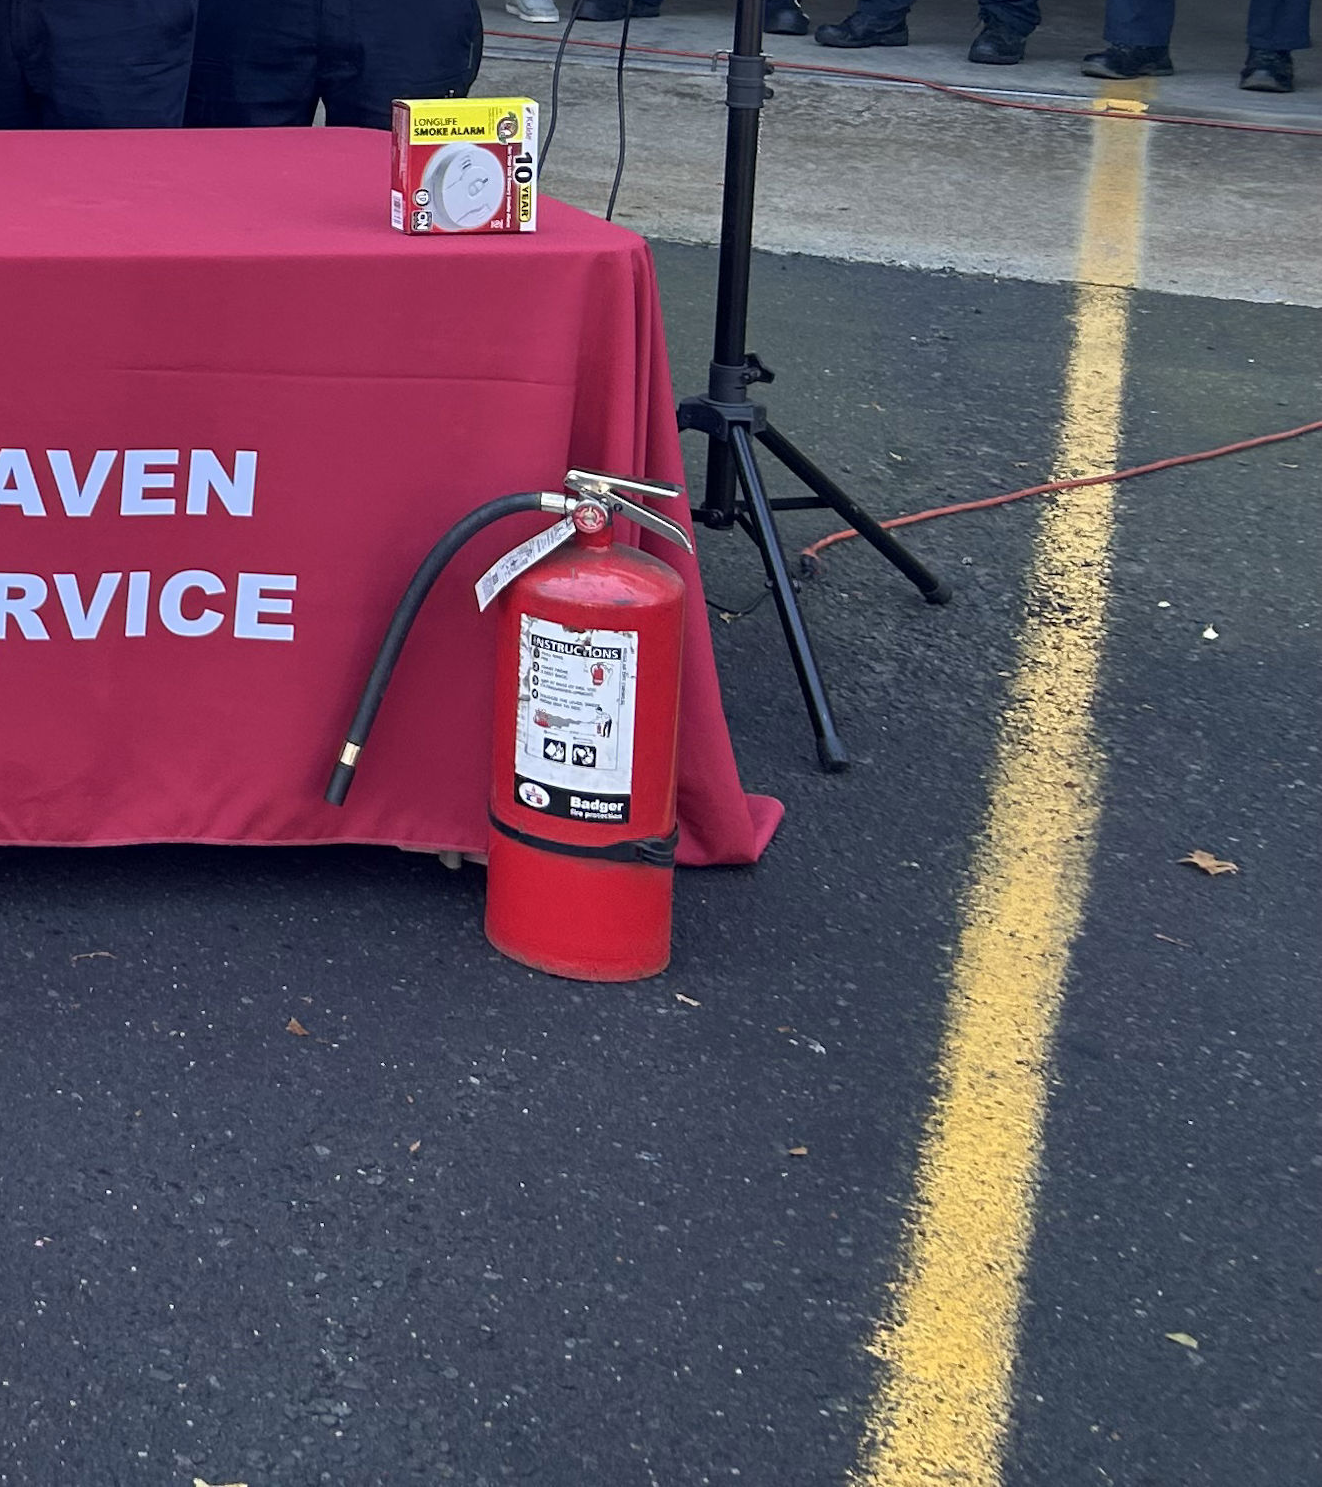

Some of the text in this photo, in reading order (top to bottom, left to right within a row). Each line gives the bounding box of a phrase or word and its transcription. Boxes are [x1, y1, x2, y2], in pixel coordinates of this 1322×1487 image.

[413, 117, 458, 127] LONGLIFE
[414, 126, 485, 137] SMOKE ALARM
[514, 152, 533, 217] 10 YEAR
[417, 212, 428, 230] ON
[570, 795, 625, 814] Badger
